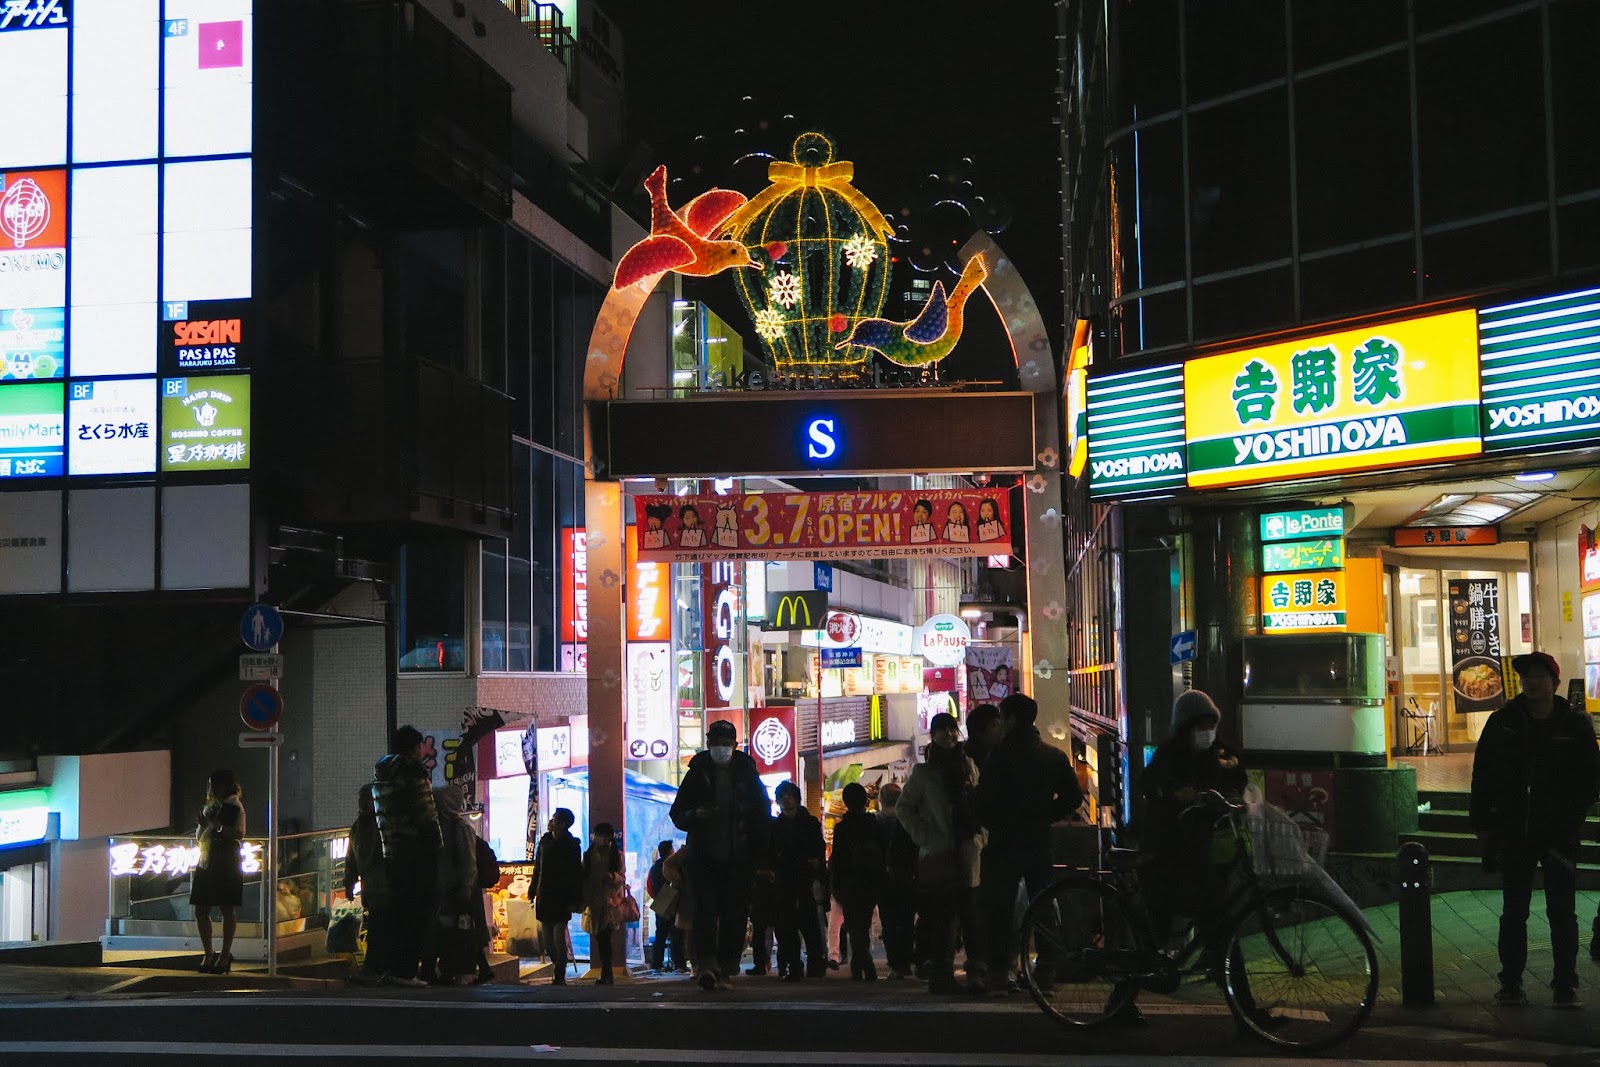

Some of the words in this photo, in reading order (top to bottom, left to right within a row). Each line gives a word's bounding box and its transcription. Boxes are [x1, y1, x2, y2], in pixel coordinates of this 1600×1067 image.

[0, 0, 68, 28] アッシュ
[168, 21, 186, 35] 4F
[167, 303, 184, 318] 1F
[174, 319, 241, 346] SASAKI
[180, 349, 202, 360] PAS
[204, 348, 211, 359] à
[213, 347, 236, 359] PAS
[74, 384, 90, 398] BF
[166, 380, 183, 394] BF
[1232, 338, 1402, 425] 吉野家
[182, 390, 208, 405] HAND
[210, 391, 232, 403] DRIP
[78, 422, 149, 440] さくら水産
[171, 430, 208, 438] HOSHINO
[211, 429, 243, 437] COFFEE
[808, 419, 836, 458] S
[1234, 417, 1407, 464] YOSHINOYA
[168, 441, 246, 464] 星乃珈琲
[1092, 451, 1183, 480] YOSHINOYA
[817, 493, 901, 513] 原宿アルタ
[743, 495, 810, 545] 3.7
[806, 516, 814, 545] SAT
[818, 512, 901, 544] OPEN!
[1271, 579, 1336, 607] 吉野家
[829, 622, 854, 634] 消火栓
[1270, 613, 1338, 627] YOSHINOYA
[1483, 583, 1500, 656] 牛すき
[924, 634, 935, 647] La
[937, 634, 967, 648] Pausa
